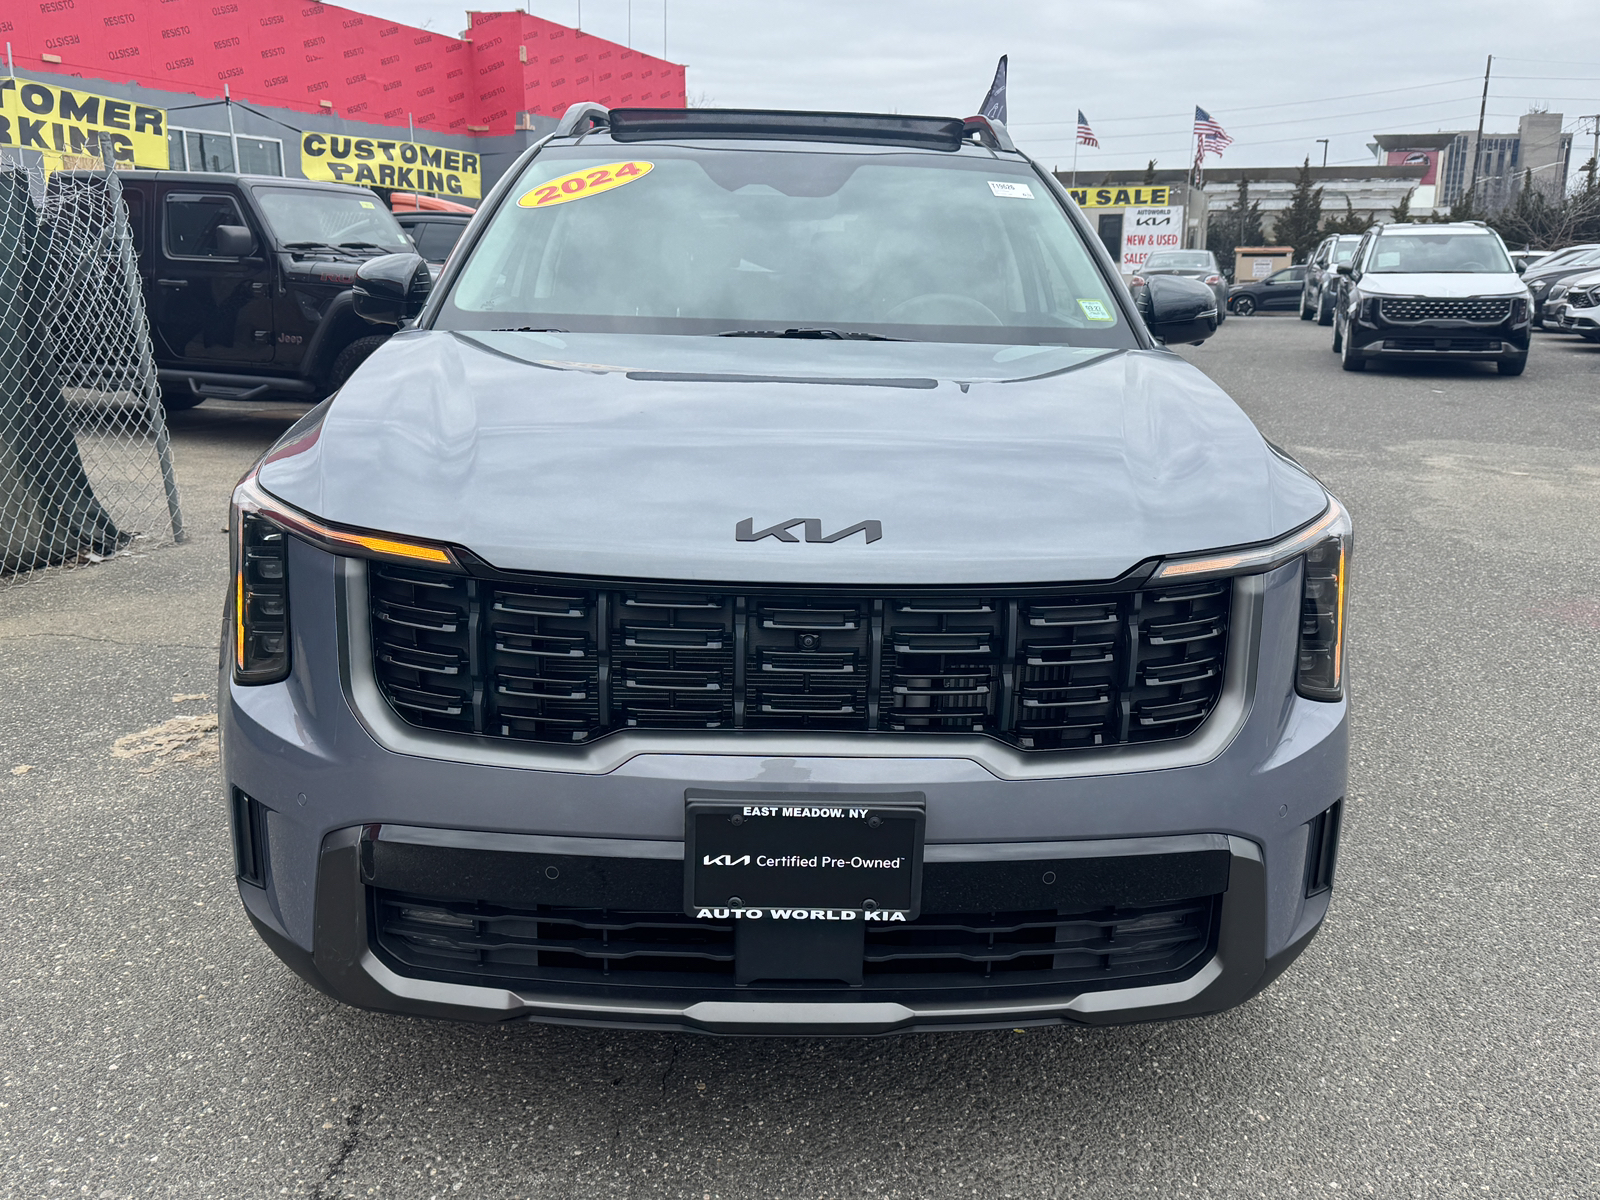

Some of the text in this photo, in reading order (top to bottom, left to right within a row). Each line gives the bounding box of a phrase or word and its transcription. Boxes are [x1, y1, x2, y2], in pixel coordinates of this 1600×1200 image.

[40, 0, 74, 13] RESISTO
[212, 4, 238, 16] RESISTO
[103, 14, 135, 27] RESISTO
[162, 26, 190, 39] RESISTO
[45, 35, 80, 49] RESISTO
[214, 37, 240, 50] RESISTO
[303, 36, 325, 48] RESISTO
[477, 37, 502, 52] RESISTO
[108, 47, 140, 61] RESISTO
[261, 47, 285, 58] RESISTO
[343, 47, 364, 58] RESISTO
[166, 58, 194, 71] RESISTO
[480, 60, 504, 75] RESISTO
[218, 67, 244, 80] RESISTO
[307, 81, 329, 93] RESISTO
[480, 86, 505, 101] RESISTO
[483, 110, 507, 124] RESISTO
[303, 133, 478, 174] CUSTOMER
[327, 161, 463, 195] PARKING
[534, 162, 642, 205] 2024
[1095, 189, 1166, 205] SALE
[1136, 217, 1171, 226] KIA
[1126, 234, 1178, 246] NEW & USED
[278, 333, 302, 345] Jeep
[735, 516, 883, 545] KIA
[743, 806, 778, 817] EAST
[849, 808, 868, 819] NY
[703, 854, 750, 866] KIA
[756, 855, 817, 868] Certified
[696, 908, 907, 922] AUTO WORLD KIA
